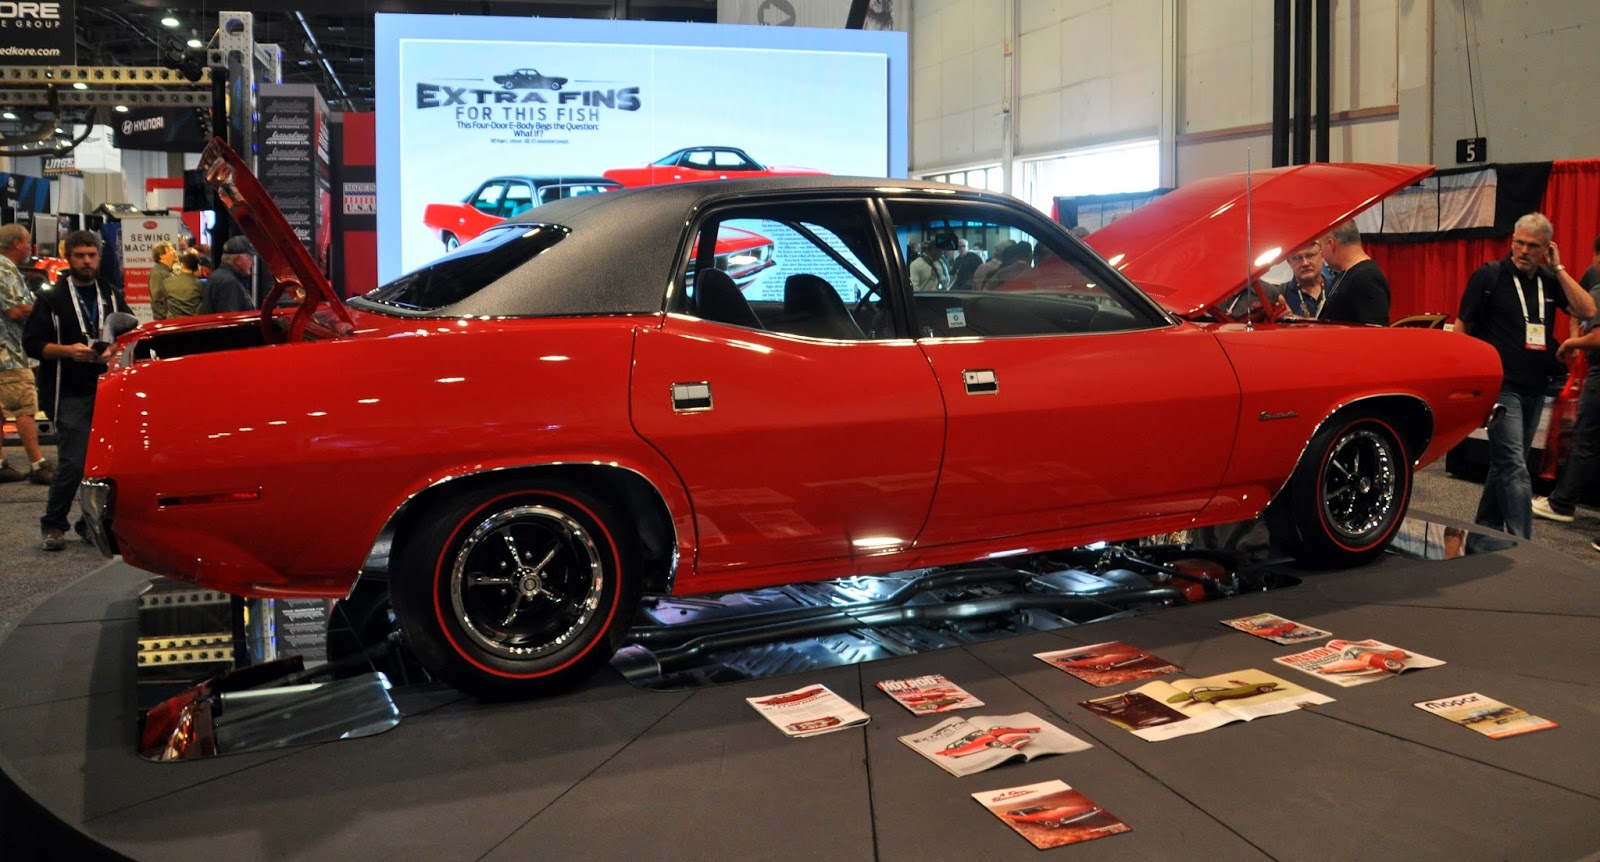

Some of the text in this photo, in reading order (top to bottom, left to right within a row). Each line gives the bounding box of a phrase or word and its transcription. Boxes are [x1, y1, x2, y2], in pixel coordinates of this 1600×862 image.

[15, 20, 60, 29] GROUP
[416, 82, 641, 112] EXTRA FINS
[455, 106, 600, 122] FOR THIS FISH
[133, 116, 165, 131] HYUNDAI
[457, 121, 599, 131] This Four-Door E-Body Begs the Question:
[1466, 144, 1475, 162] 5
[346, 204, 376, 212] U.S.A.
[130, 234, 170, 242] SEWING
[124, 244, 177, 252] MACHS
[884, 675, 938, 691] HOT ROD
